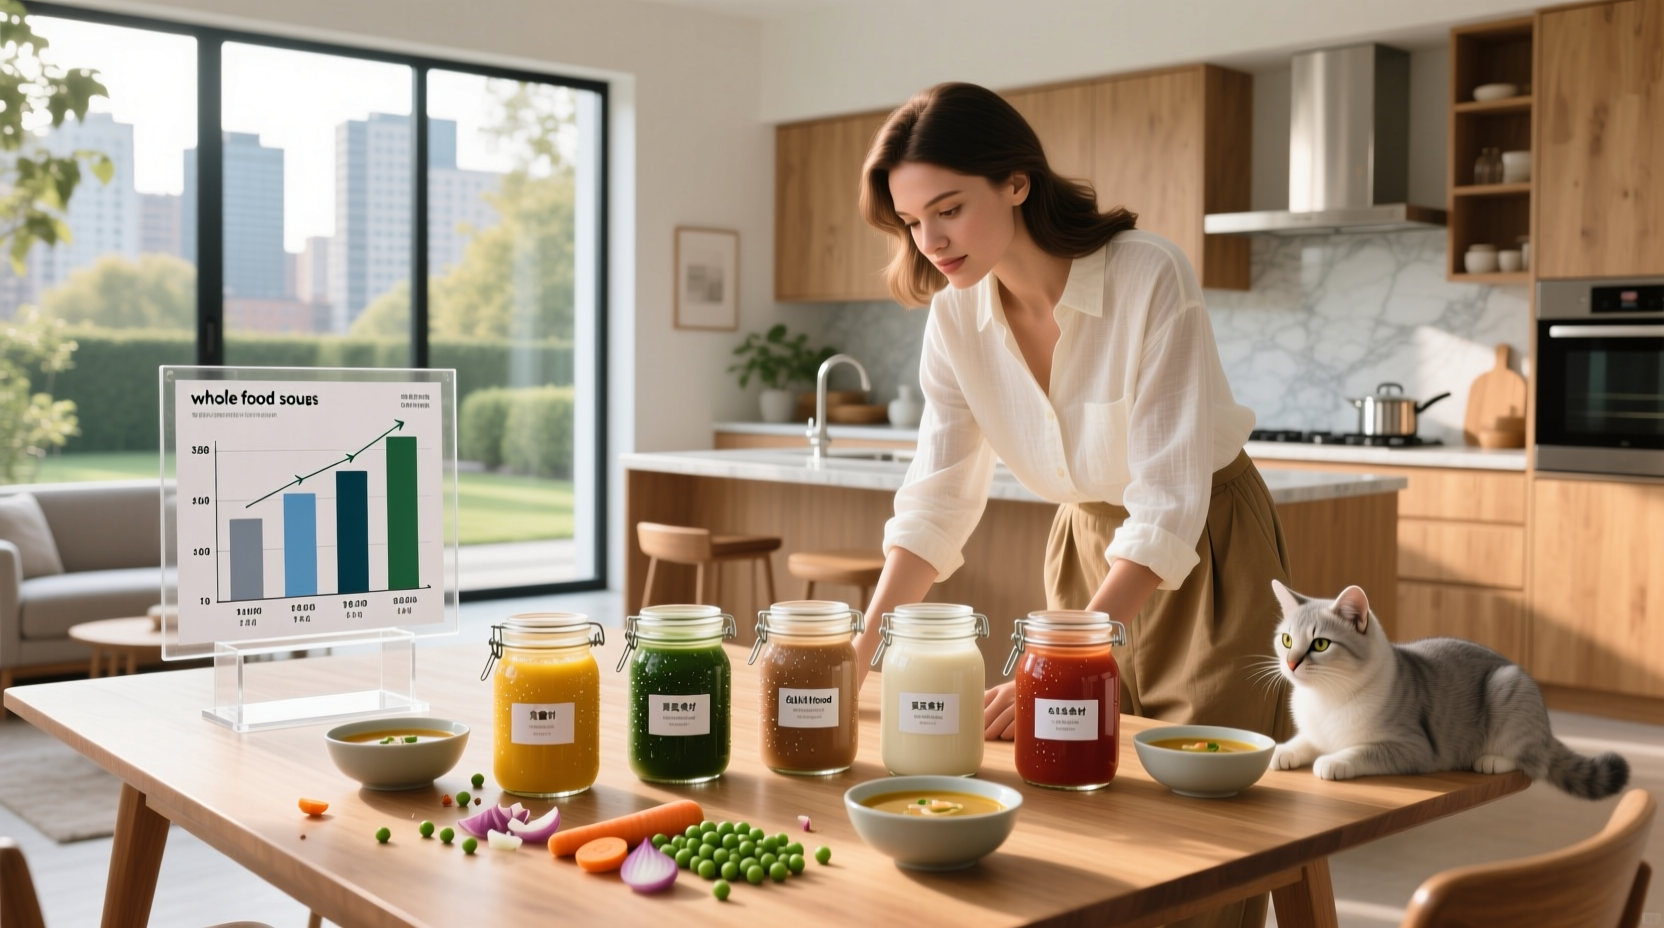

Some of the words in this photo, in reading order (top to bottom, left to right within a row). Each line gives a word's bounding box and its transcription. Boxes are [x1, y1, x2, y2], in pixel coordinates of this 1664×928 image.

[190, 389, 238, 406] whole
[241, 389, 275, 406] food
[200, 597, 211, 606] 10
